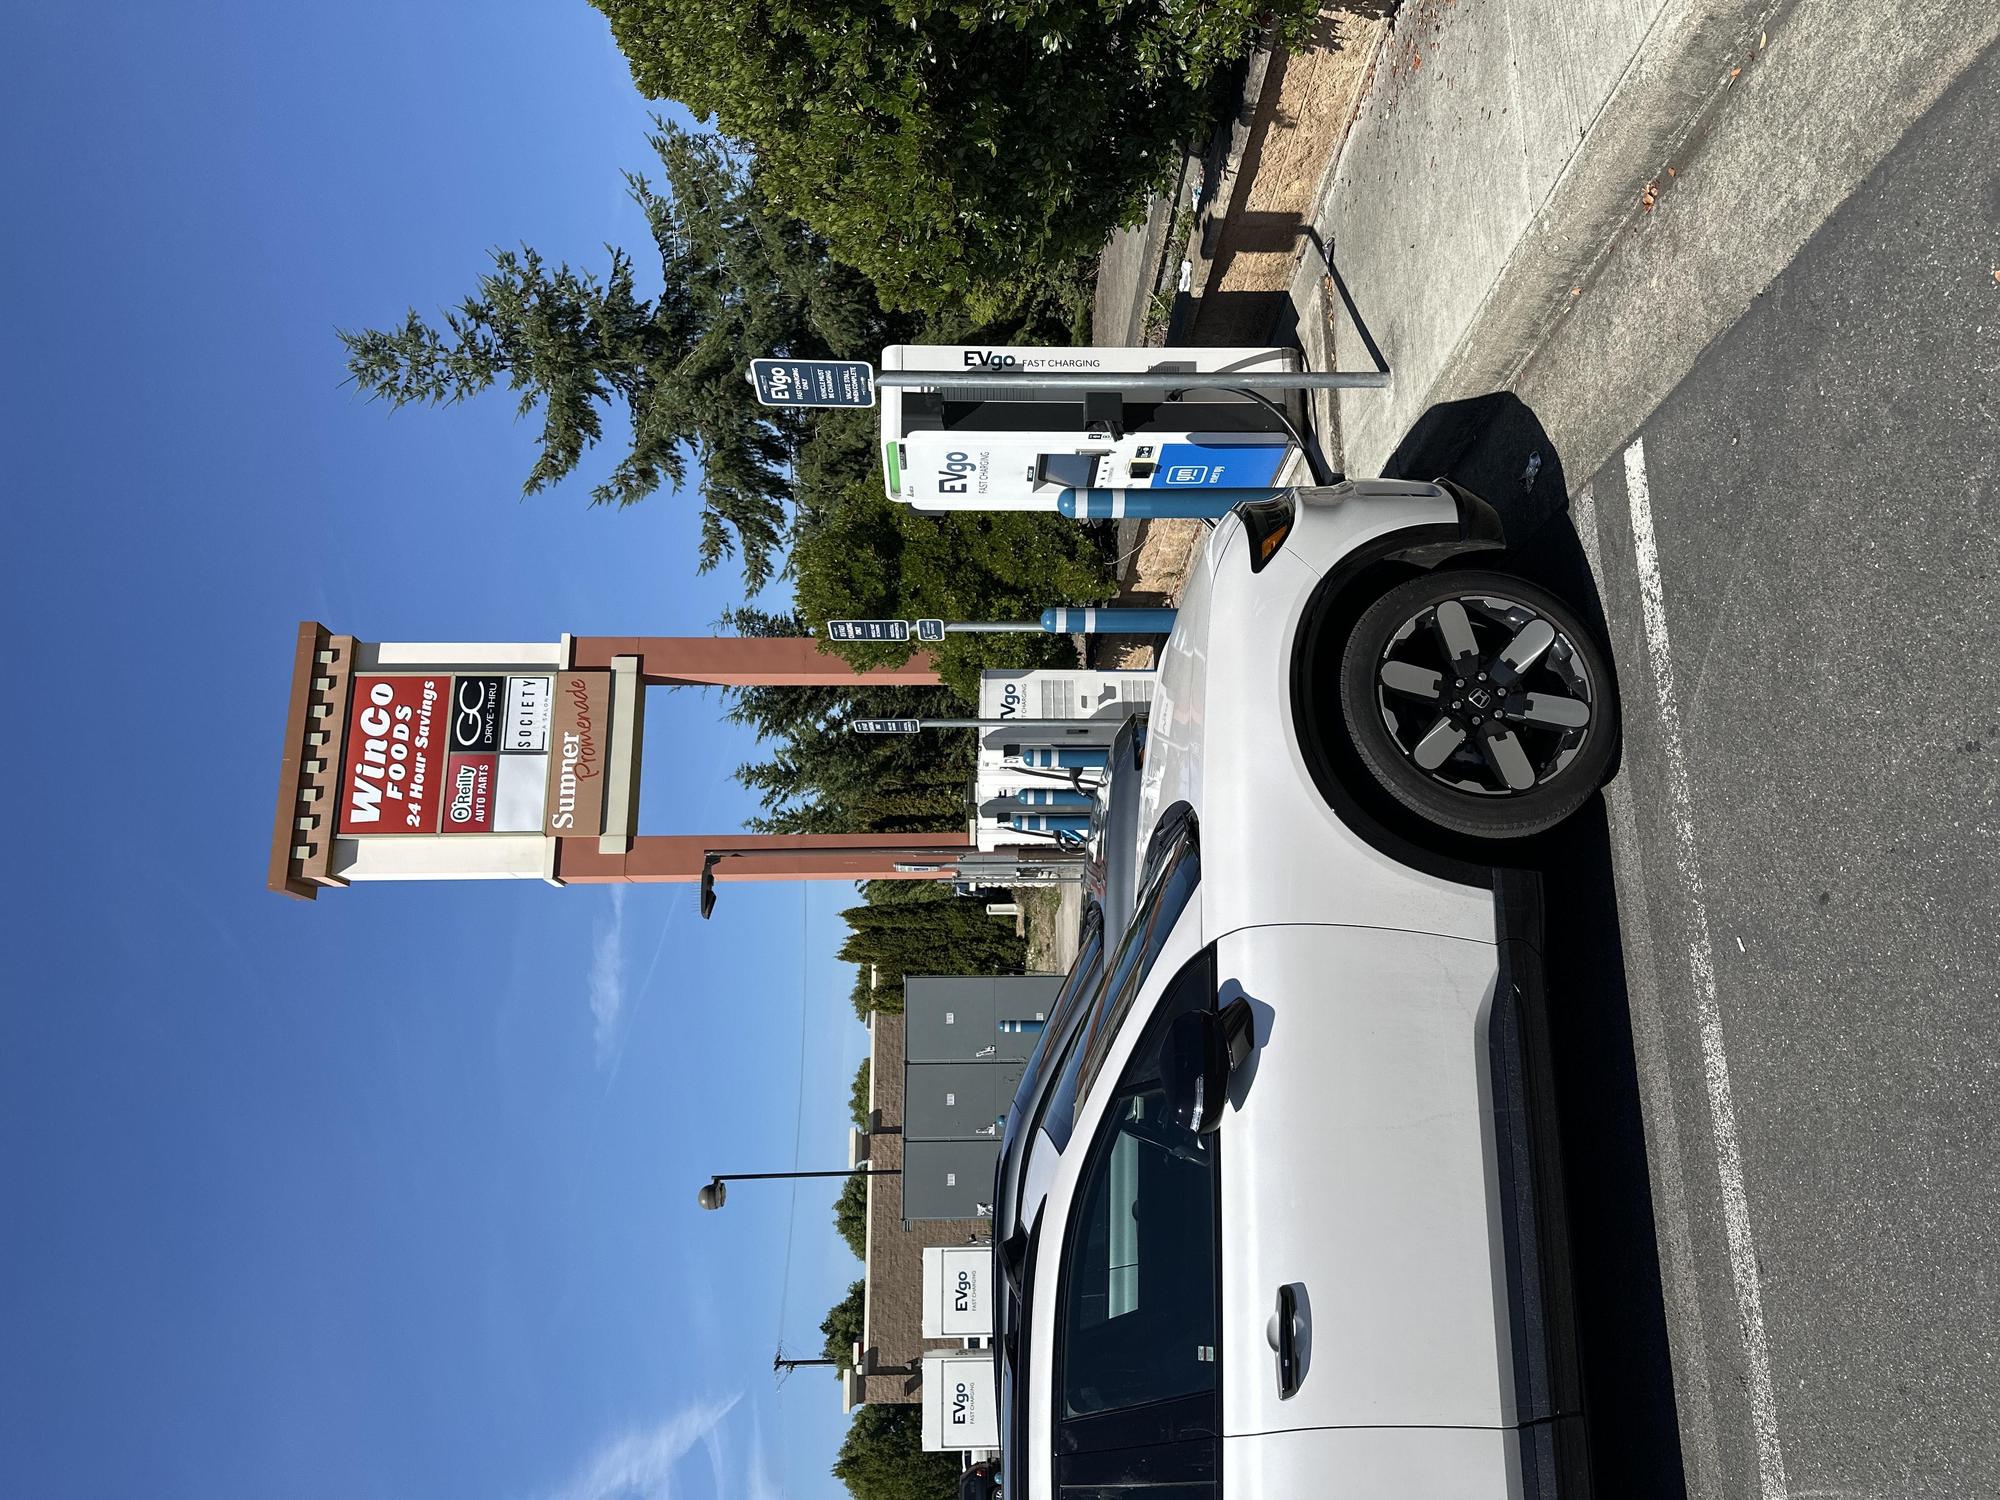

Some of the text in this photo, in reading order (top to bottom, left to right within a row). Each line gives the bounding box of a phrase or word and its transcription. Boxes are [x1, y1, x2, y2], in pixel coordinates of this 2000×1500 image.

[825, 370, 834, 392] CHARGING
[850, 367, 858, 390] COMPLETE
[964, 350, 1100, 370] EVgo FAST CHARGING
[769, 367, 792, 400] EVgo
[792, 368, 804, 400] FAST CHARGING
[817, 369, 828, 400] VEHICLE MUST
[844, 384, 852, 400] VACATE
[938, 452, 976, 494] EVgo
[978, 452, 990, 494] FAST CHARGING
[1176, 469, 1198, 481] gm
[1208, 466, 1225, 484] energy
[456, 680, 484, 746] GC
[484, 682, 498, 744] DRIVE-THRU
[517, 680, 536, 748] SOCIETY
[565, 678, 600, 782] Promenade
[350, 683, 394, 824] WinCo
[386, 704, 412, 800] FOODS
[406, 680, 438, 828] 24 Hour Savings
[451, 766, 476, 822] O'Reilly
[475, 764, 489, 822] AUTO PARTS
[552, 731, 580, 829] Sumner
[955, 1271, 971, 1312] EVgo
[953, 1382, 969, 1424] EVgo
